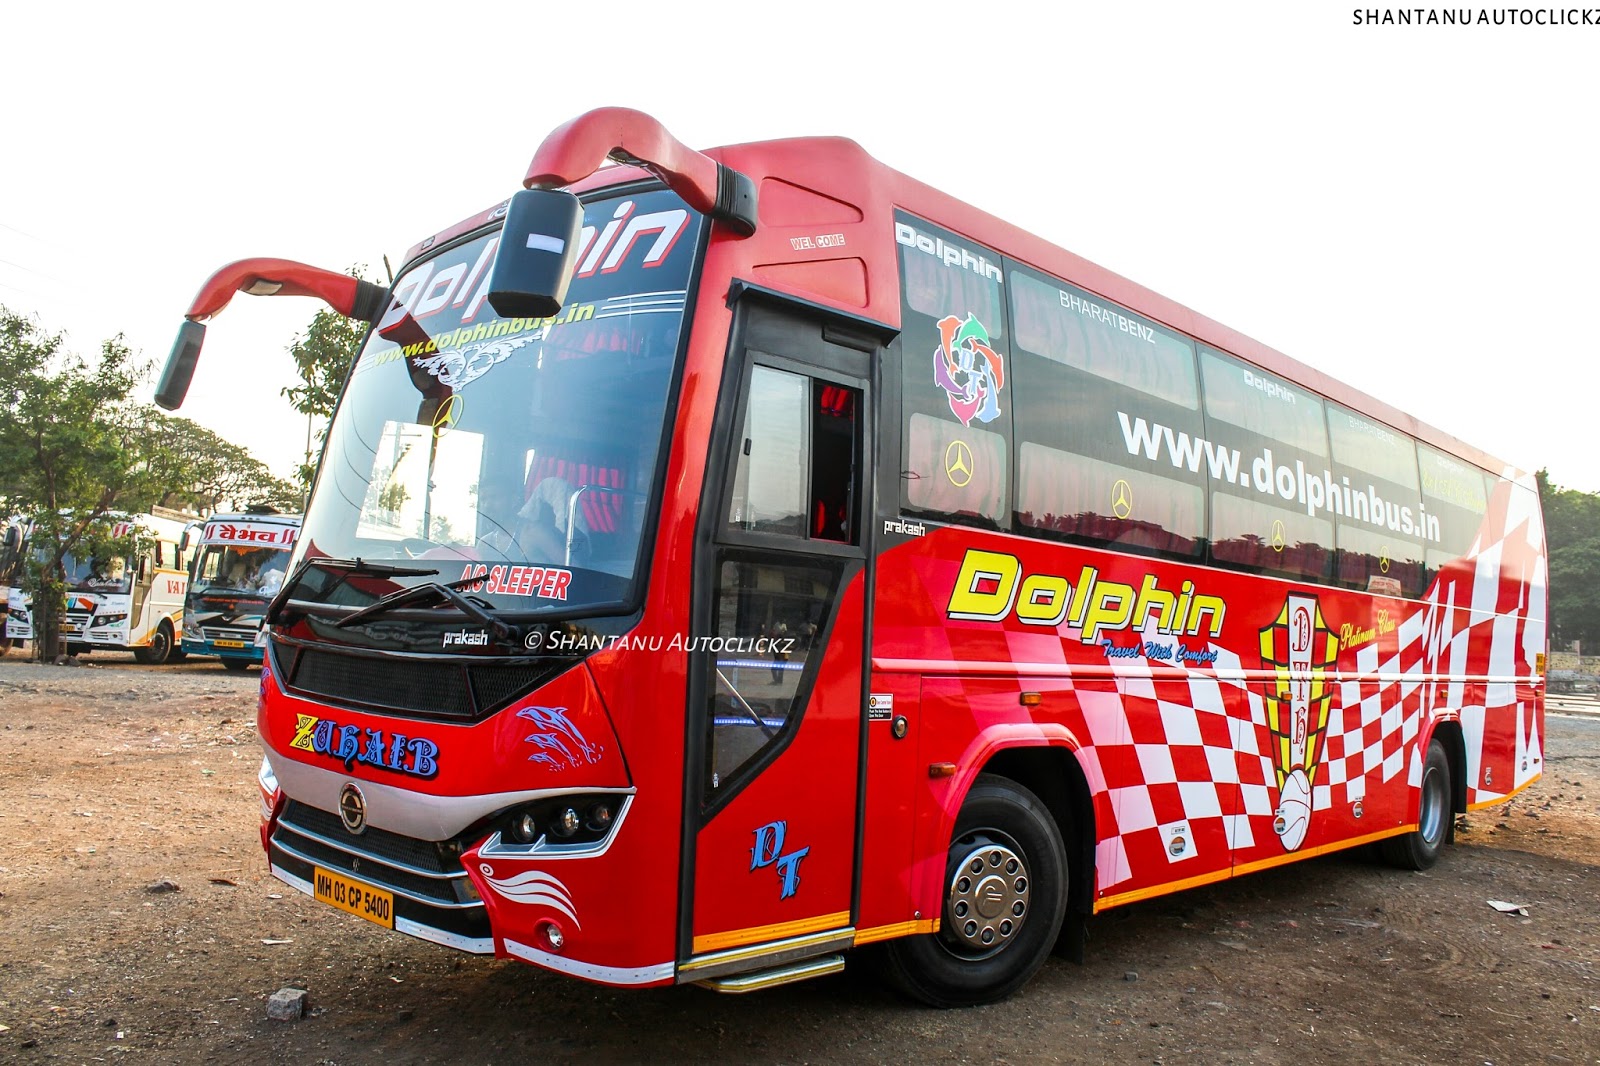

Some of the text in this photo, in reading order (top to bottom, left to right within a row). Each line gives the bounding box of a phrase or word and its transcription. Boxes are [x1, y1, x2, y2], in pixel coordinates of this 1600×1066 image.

[790, 233, 846, 250] WEL COME
[895, 221, 1003, 284] Dolphin
[1058, 290, 1156, 345] BHARATBENZ
[1243, 368, 1297, 405] Dolphin
[1117, 410, 1441, 543] www.dolphinbus.in
[883, 519, 926, 537] prakash
[487, 565, 573, 601] SLEEPER
[947, 548, 1226, 646] Dolphin
[442, 630, 488, 648] prakash
[1101, 639, 1219, 665] Travel With Comfort
[1340, 623, 1376, 651] Platinum
[317, 874, 390, 921] MH 03 CP 5400
